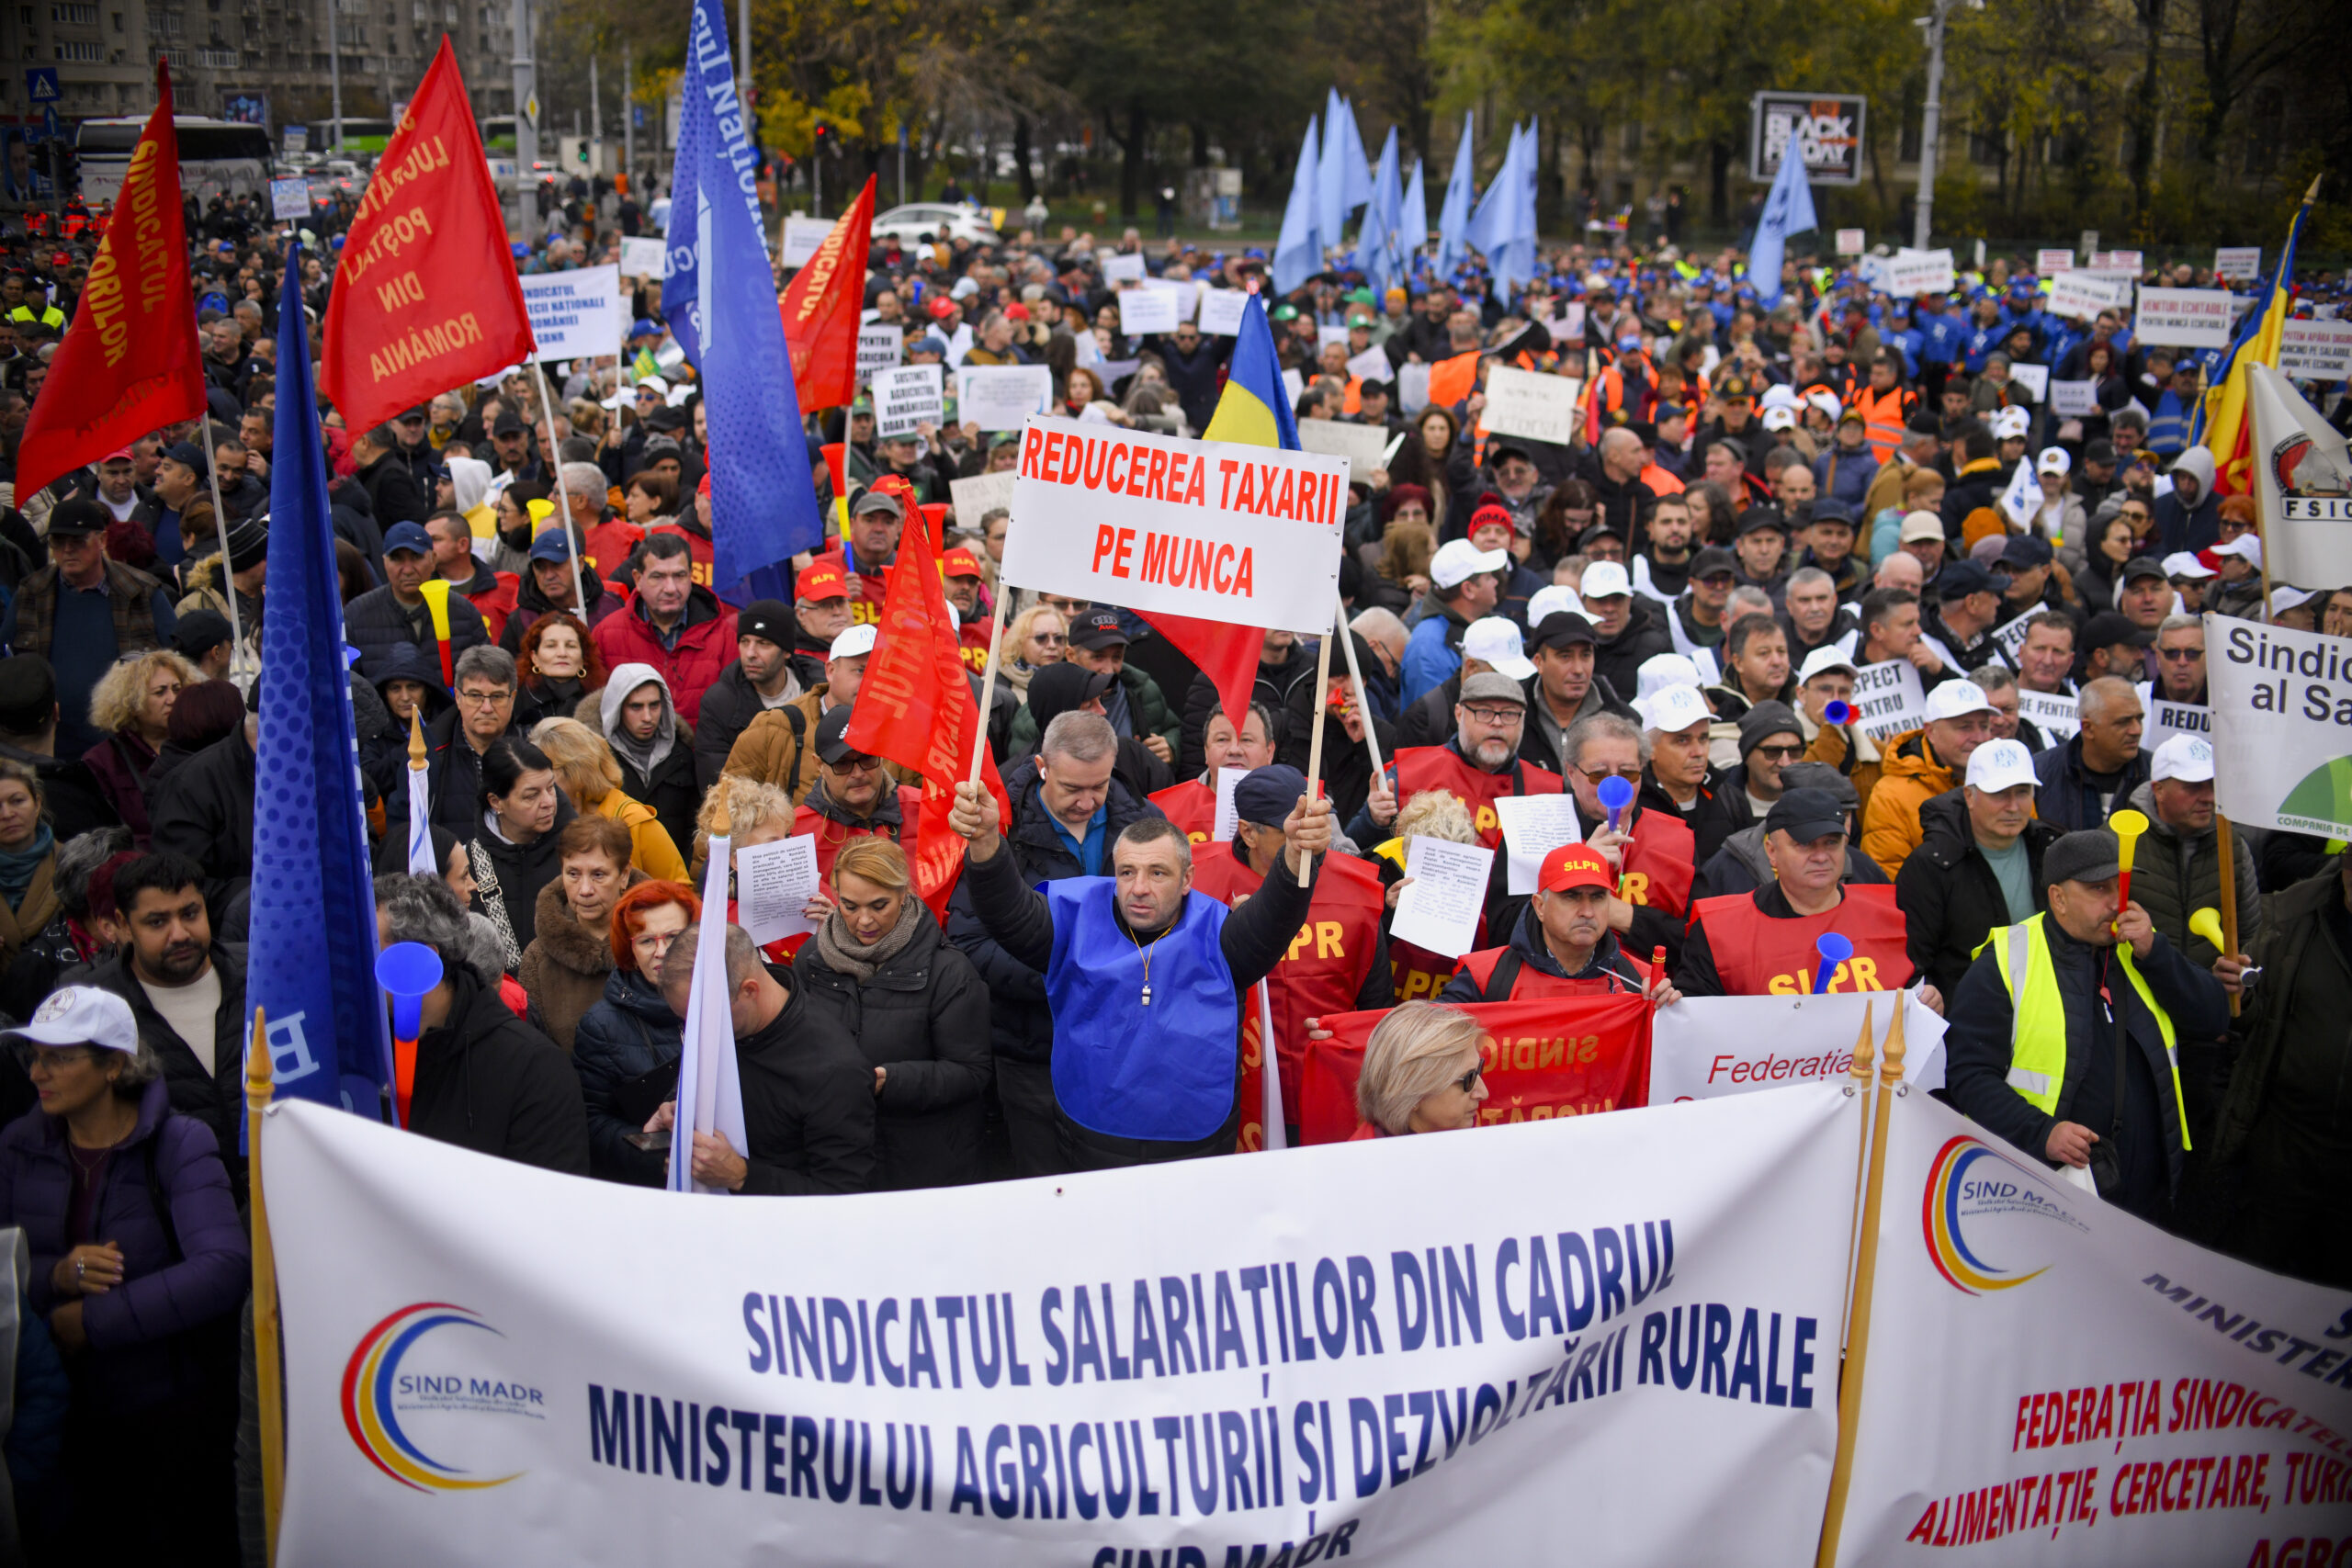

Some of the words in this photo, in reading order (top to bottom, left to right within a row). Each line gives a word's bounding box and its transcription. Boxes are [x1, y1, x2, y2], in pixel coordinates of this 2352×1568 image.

[127, 140, 169, 313] SINDICATUL
[87, 232, 129, 367] TORILOR
[1022, 426, 1205, 507] REDUCEREA
[1219, 459, 1340, 525] TAXARII
[1091, 524, 1136, 579] PE
[1140, 532, 1253, 599] MUNCA
[2160, 707, 2211, 733] REDU
[2251, 679, 2288, 714] al
[2277, 816, 2334, 834] COMPANIA
[2336, 825, 2350, 837] DE
[1564, 860, 1601, 873] SLPR
[1280, 920, 1346, 962] PR
[1963, 1180, 2018, 1200] SIND
[741, 1291, 1032, 1390] SINDICATUL
[1041, 1254, 1384, 1398] SALARIAȚILOR
[1391, 1243, 1483, 1352] DIN
[1495, 1219, 1675, 1341] CADRUL
[399, 1375, 462, 1394] SIND
[470, 1378, 544, 1405] MADR
[588, 1383, 933, 1512] MINISTERULUI
[949, 1406, 1283, 1520] AGRICULTURII
[1294, 1400, 1336, 1535] ȘI
[1348, 1325, 1628, 1499] DEZVOLTĂRII
[1636, 1303, 1817, 1409] RURALE
[2012, 1380, 2161, 1454] FEDERAȚIA
[1905, 1467, 2098, 1547] ALIMENTAȚIE,
[2109, 1453, 2271, 1517] CERCETARE,
